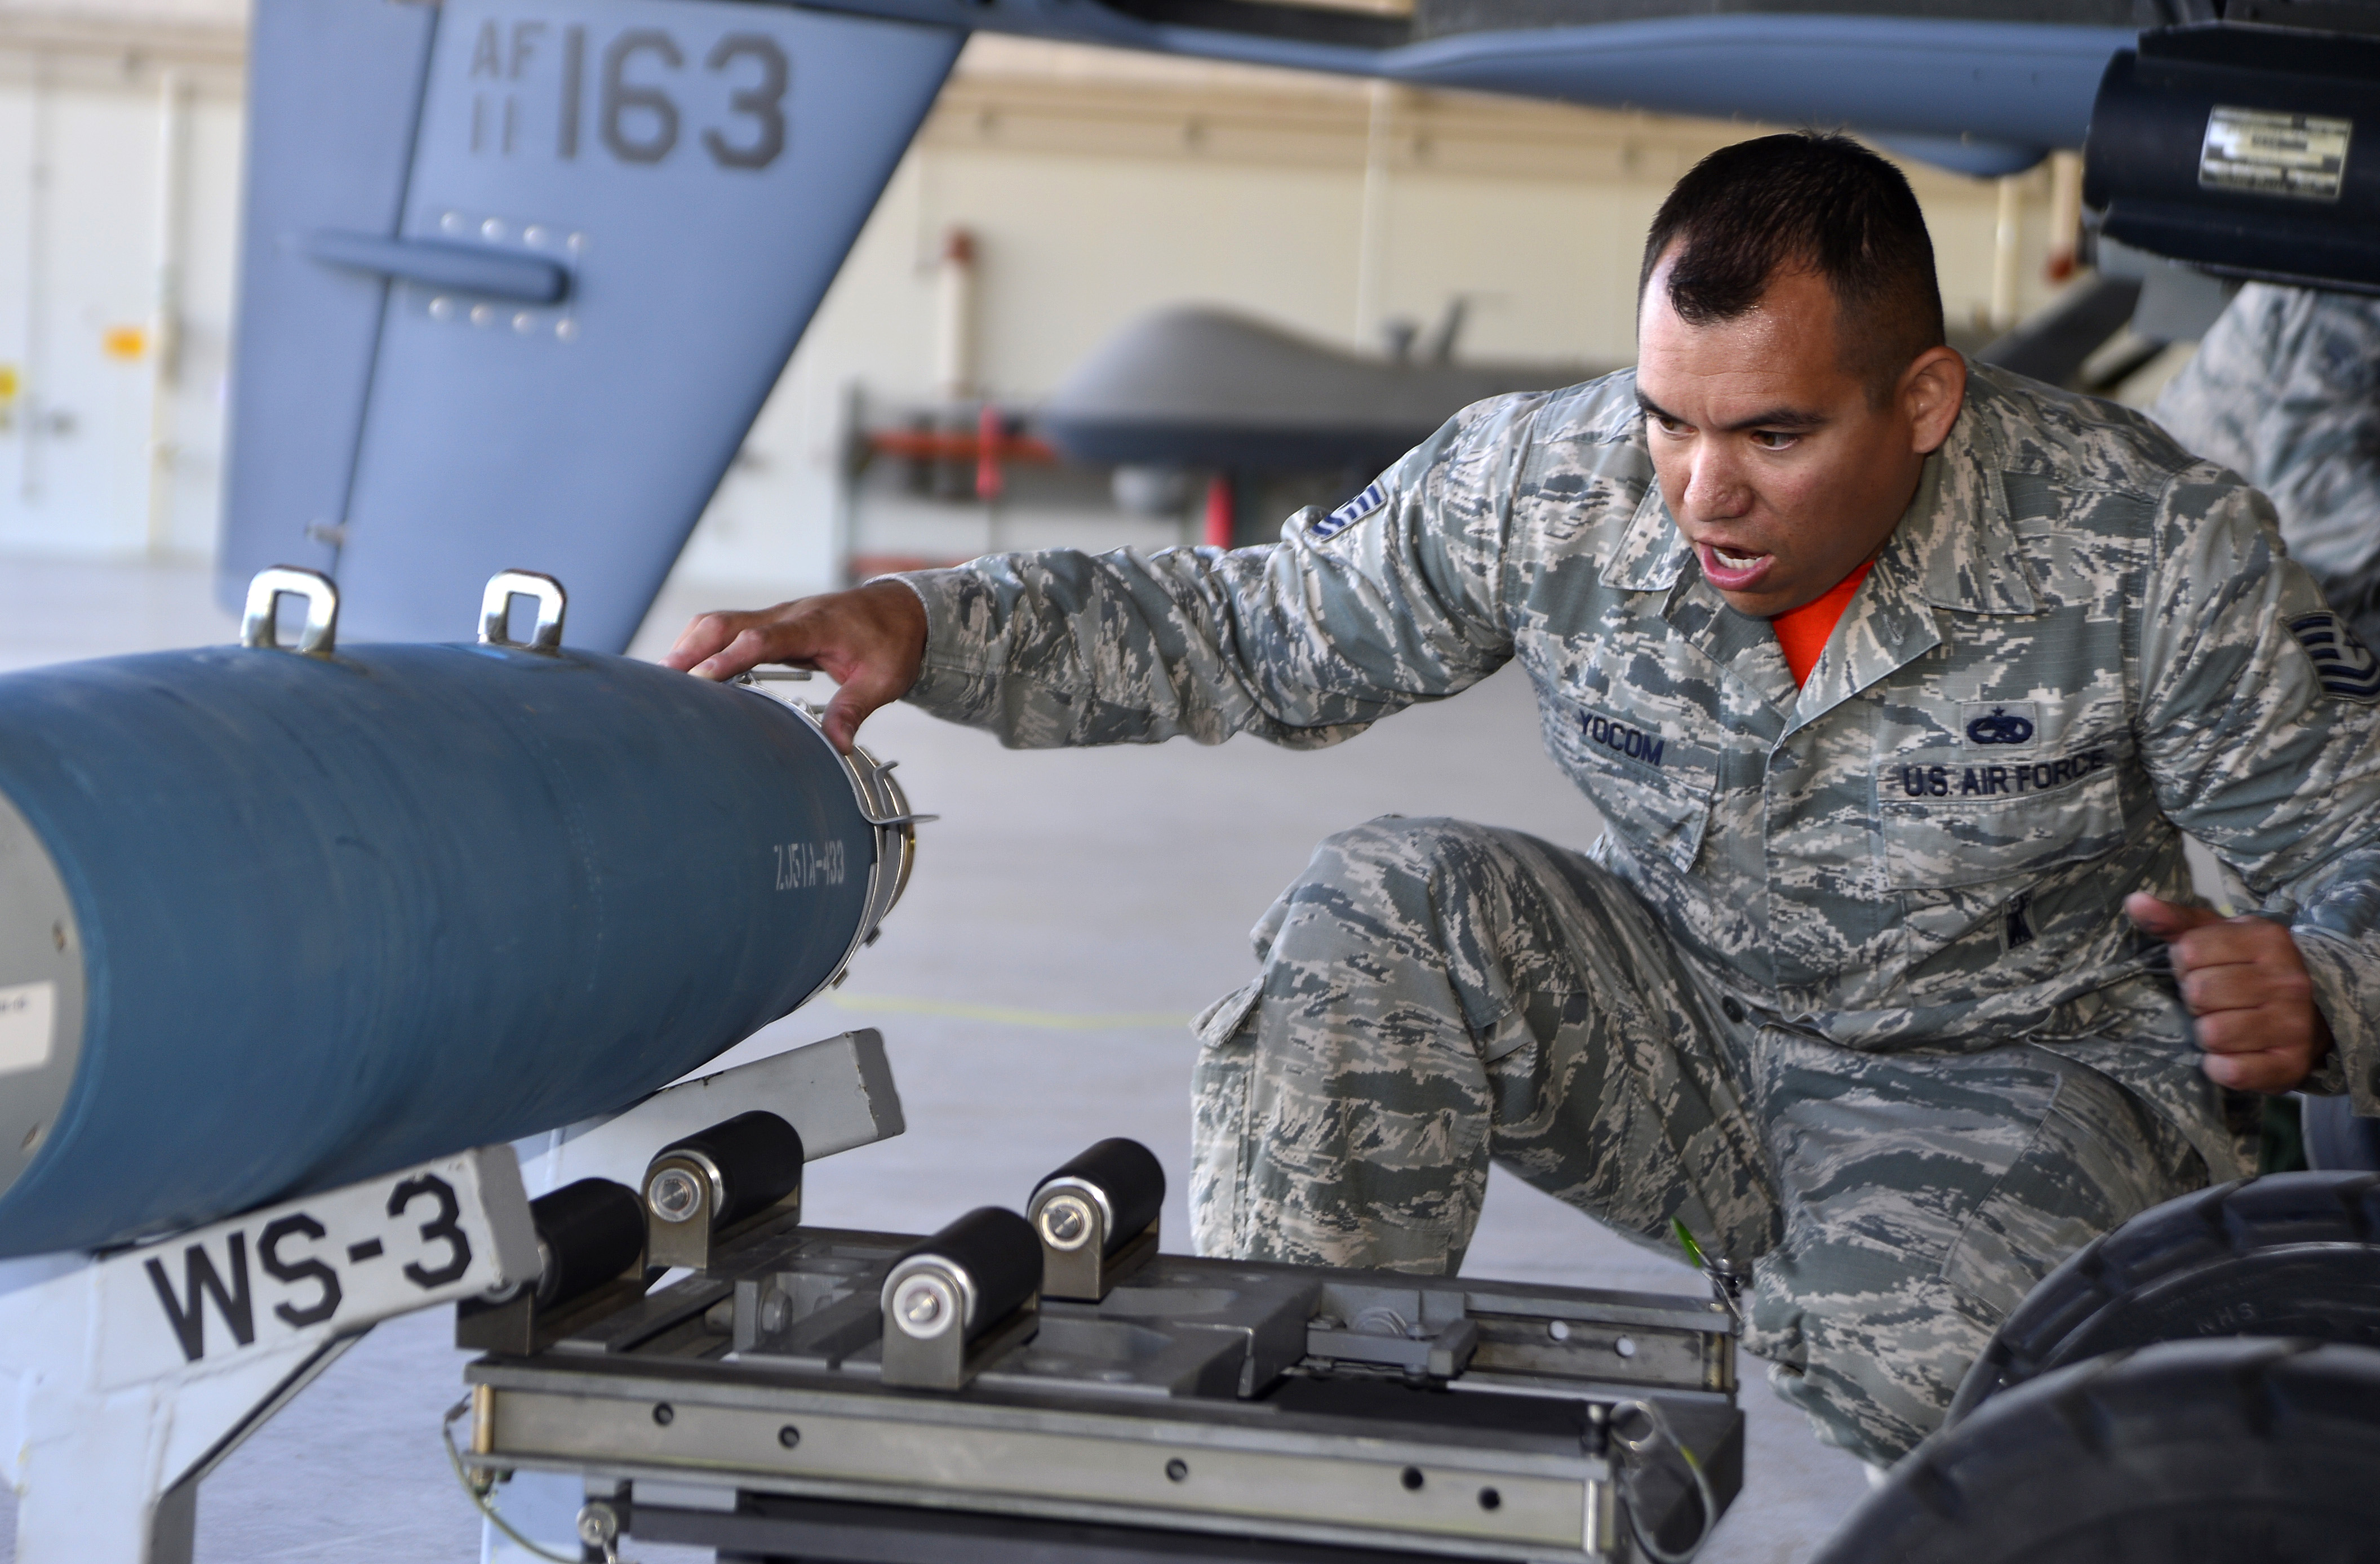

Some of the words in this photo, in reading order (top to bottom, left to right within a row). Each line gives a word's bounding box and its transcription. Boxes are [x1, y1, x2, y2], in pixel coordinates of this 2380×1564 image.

[469, 19, 549, 80] AF
[558, 24, 790, 169] 163
[1579, 708, 1665, 767] YOCOM
[1902, 766, 1953, 797] U.S.
[1961, 766, 2010, 796] AIR
[2014, 748, 2105, 792] FORCE
[143, 1173, 472, 1363] WS-3
